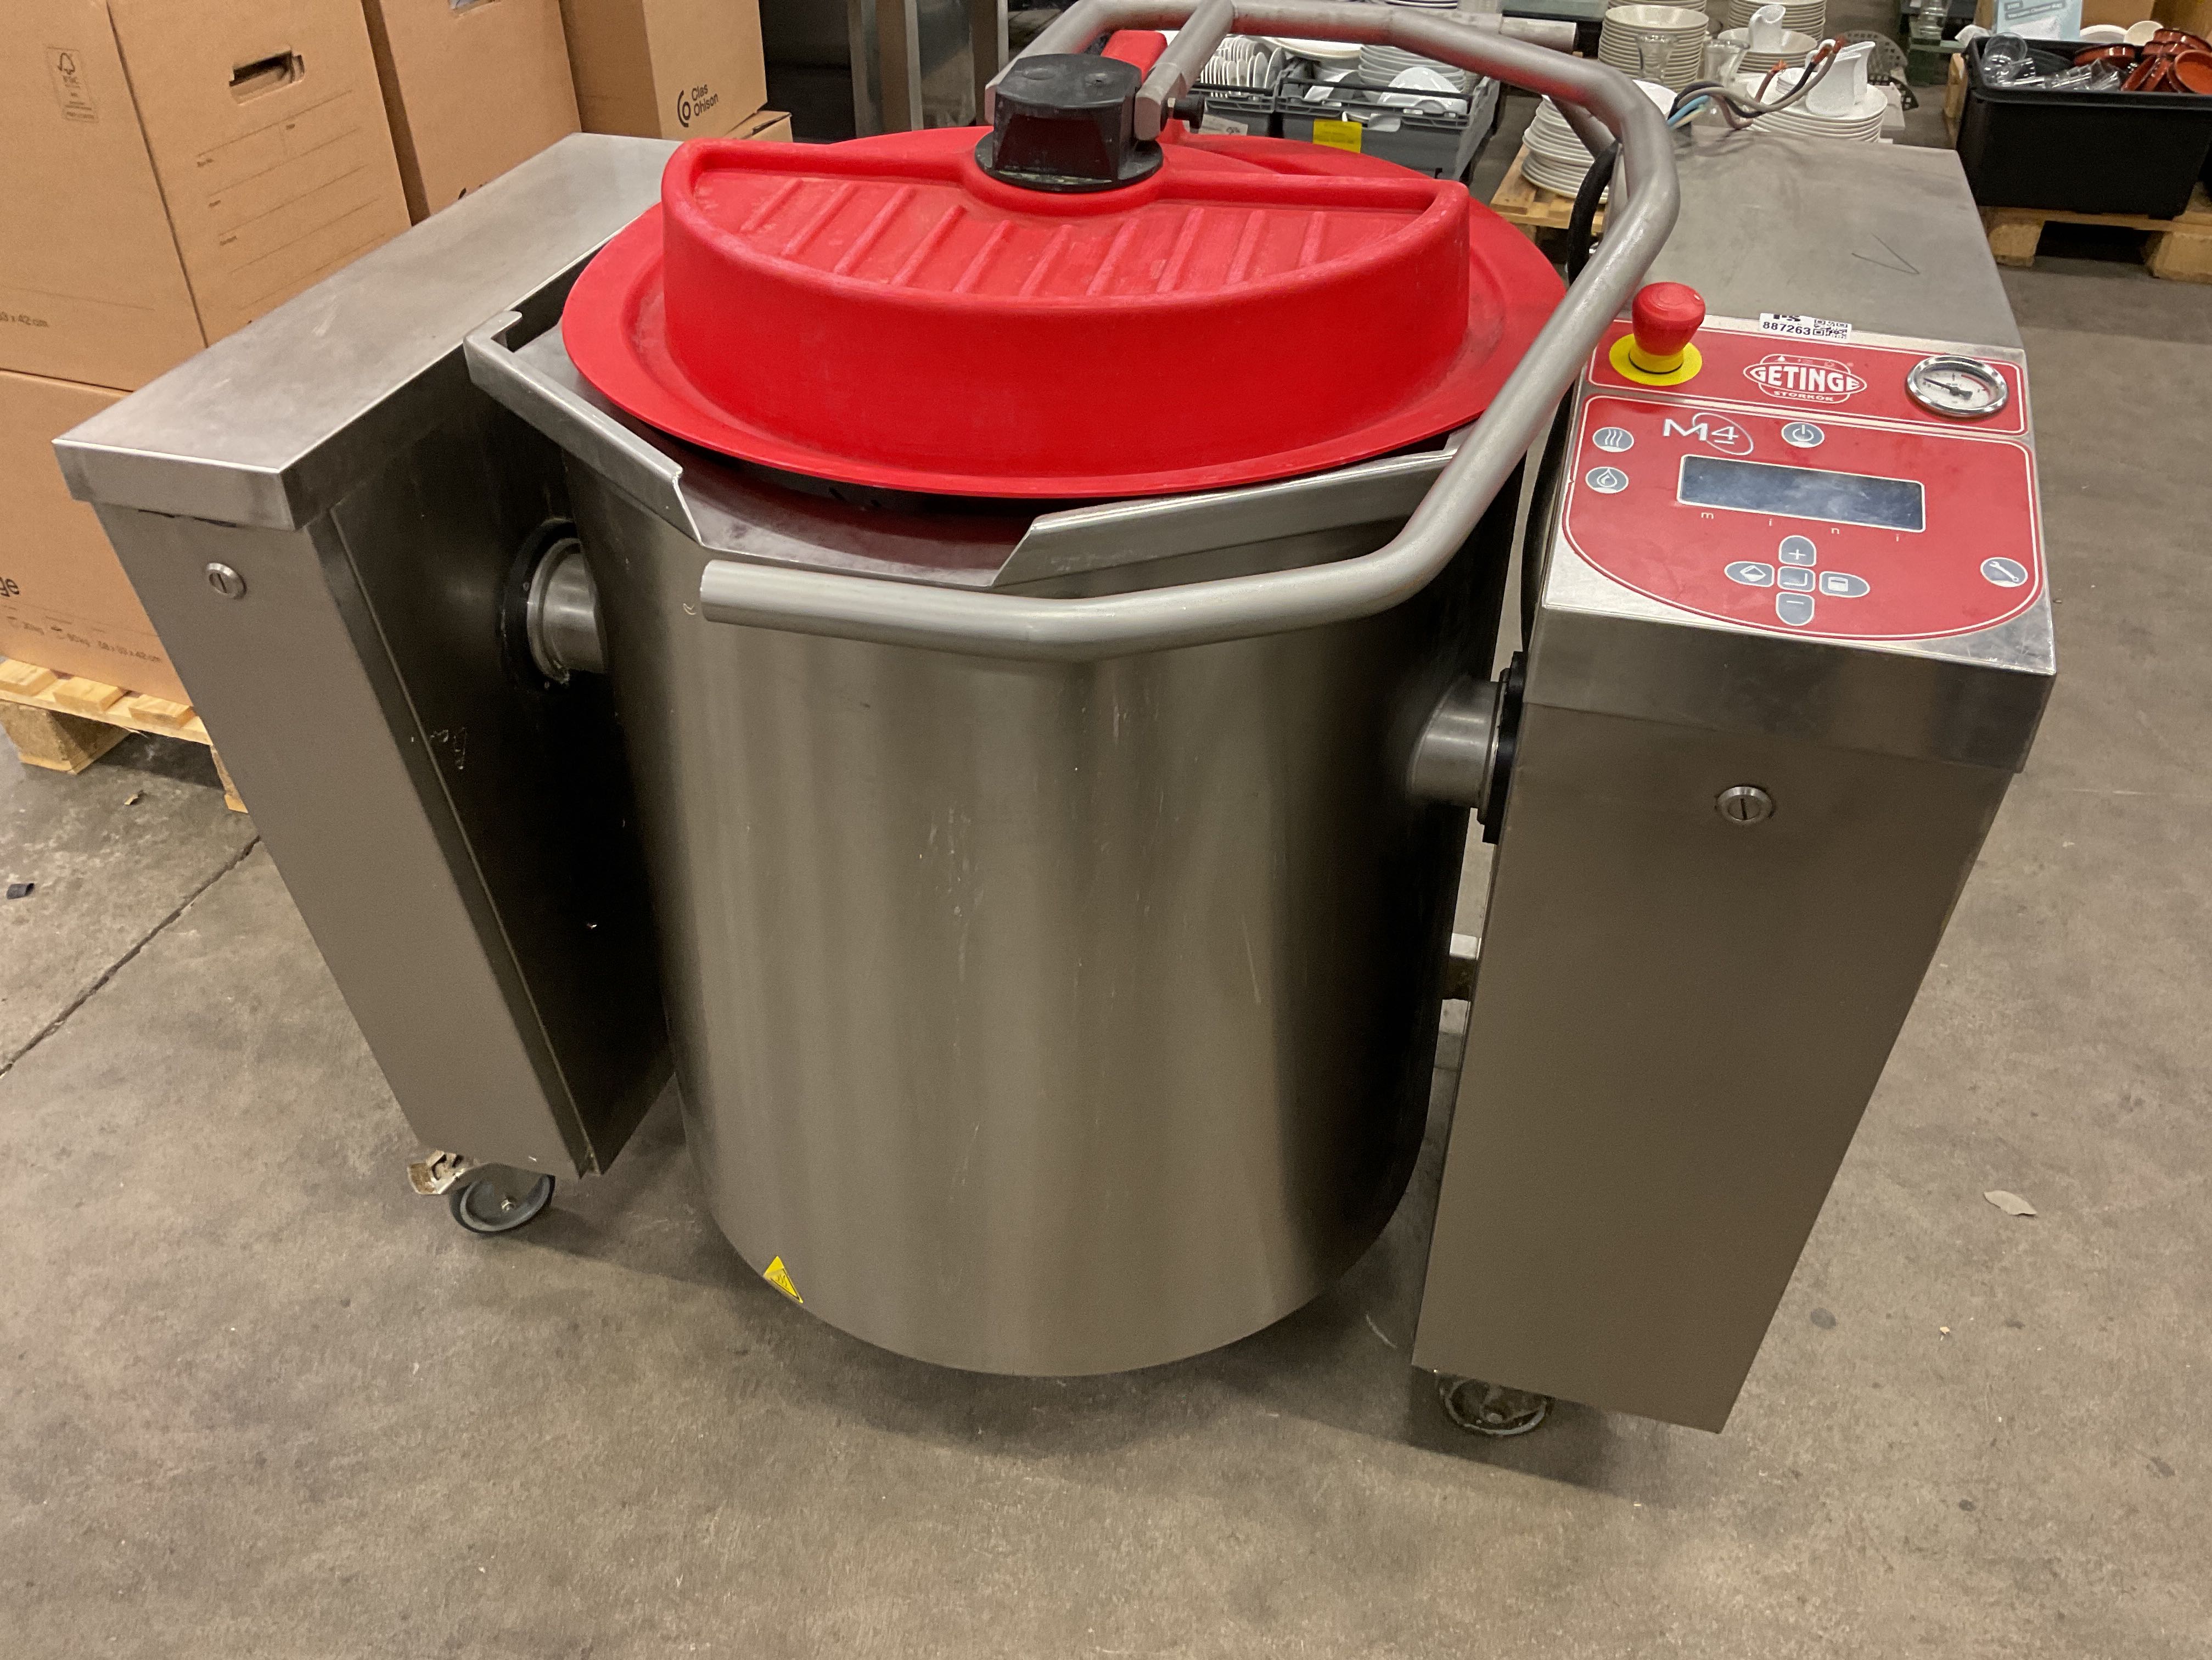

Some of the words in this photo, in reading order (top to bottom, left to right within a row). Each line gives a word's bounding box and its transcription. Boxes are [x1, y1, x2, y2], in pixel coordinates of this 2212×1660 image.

[692, 84, 708, 101] Clas
[694, 93, 718, 116] Ohlson
[1762, 321, 1811, 335] 887263
[1749, 366, 1861, 392] GETINGE
[1663, 419, 1739, 441] M4
